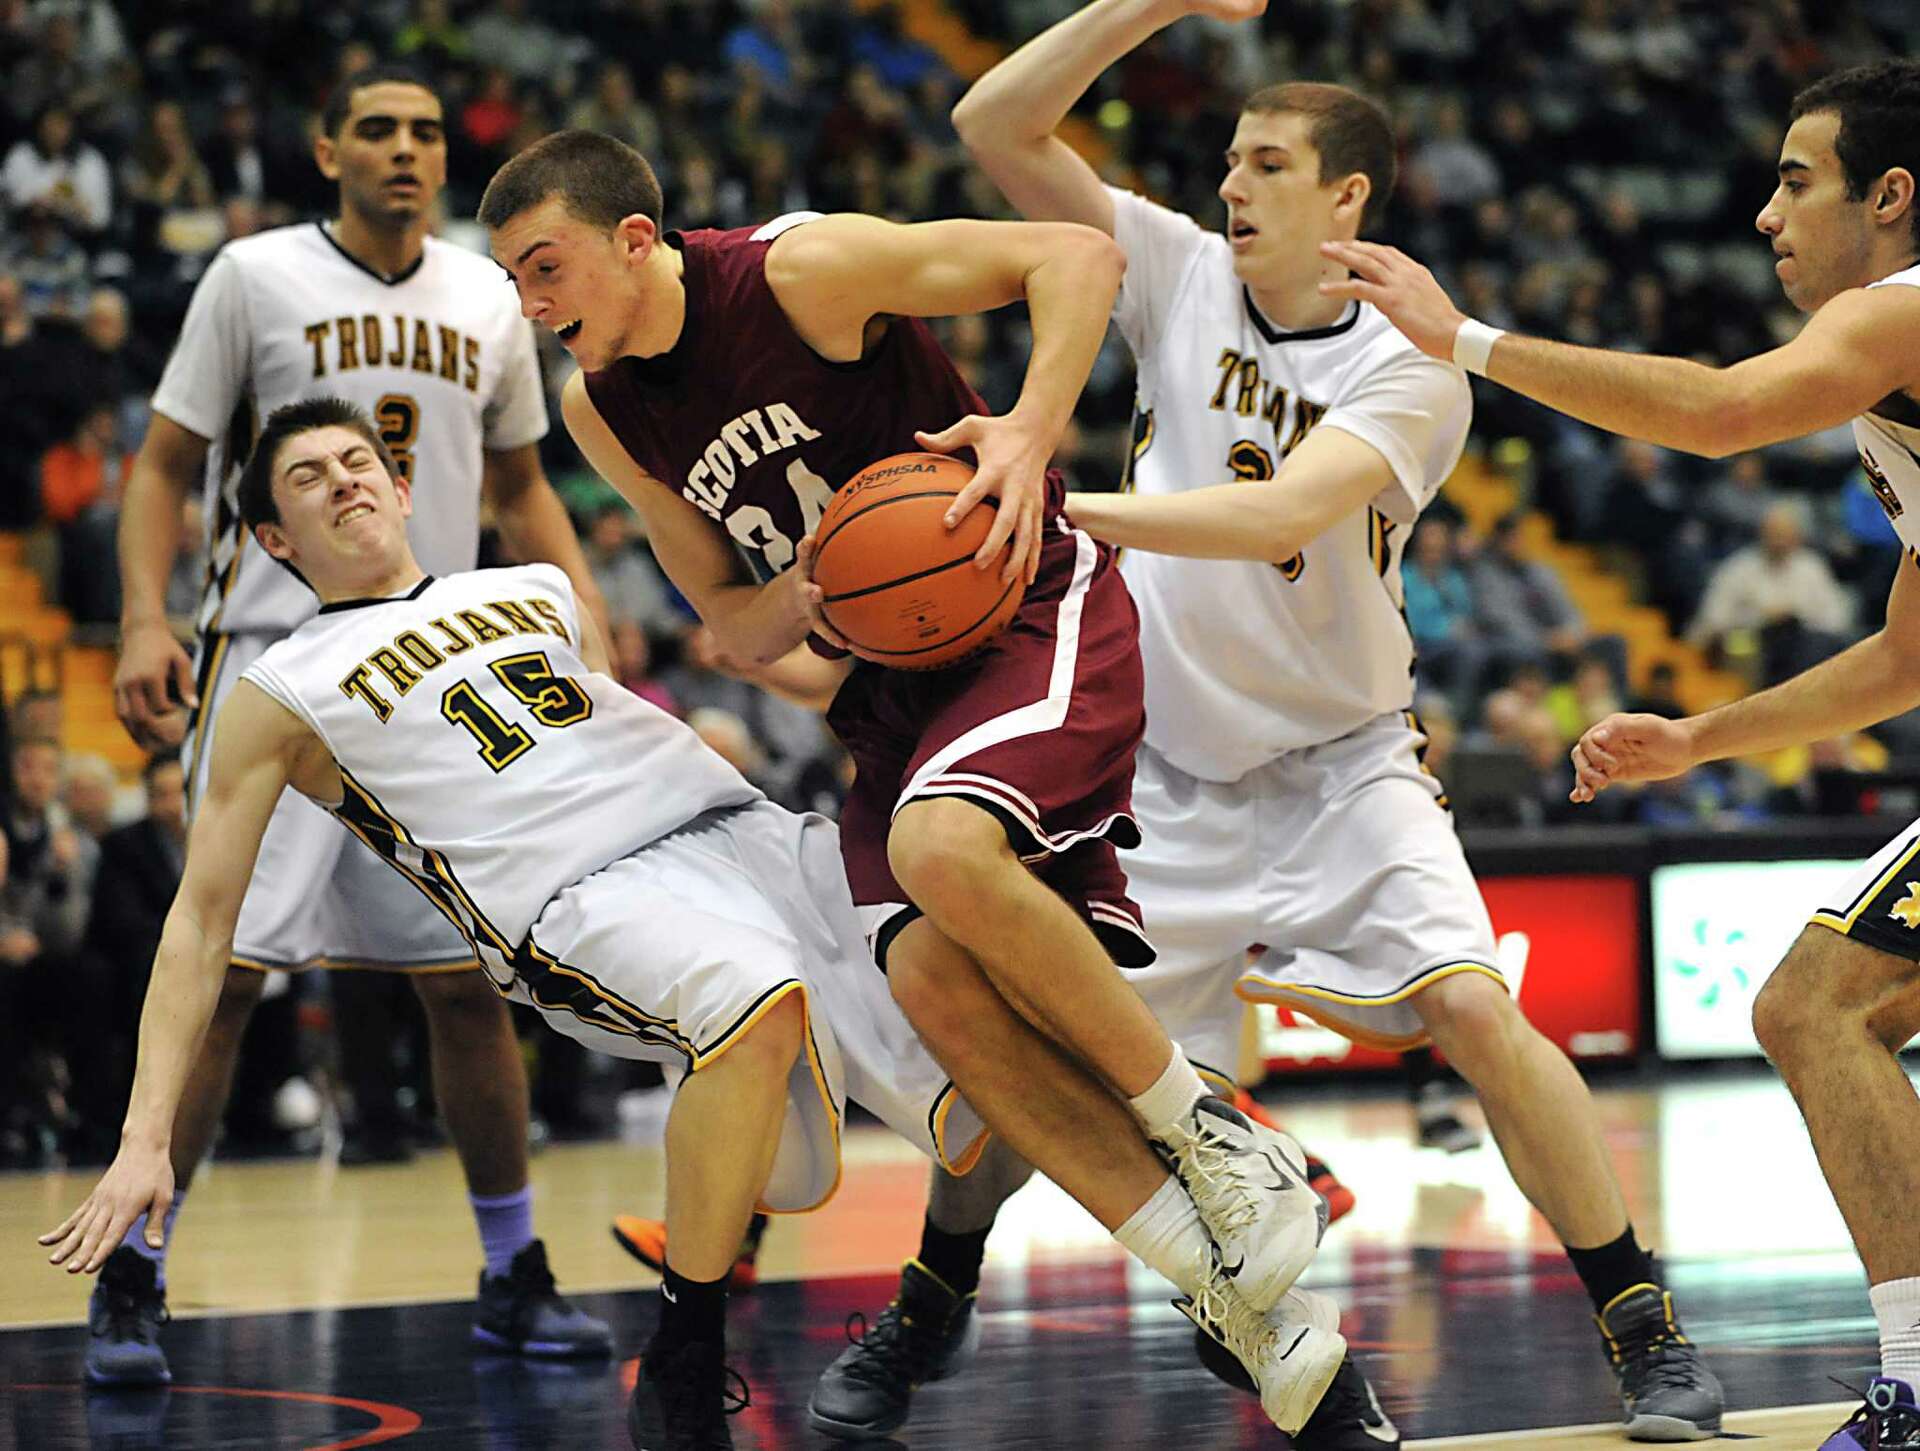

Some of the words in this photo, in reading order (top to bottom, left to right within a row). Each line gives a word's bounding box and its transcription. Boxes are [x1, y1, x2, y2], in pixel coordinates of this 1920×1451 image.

[304, 315, 480, 392] TROJANS
[338, 599, 573, 724] TROJANS
[440, 650, 594, 774] 15
